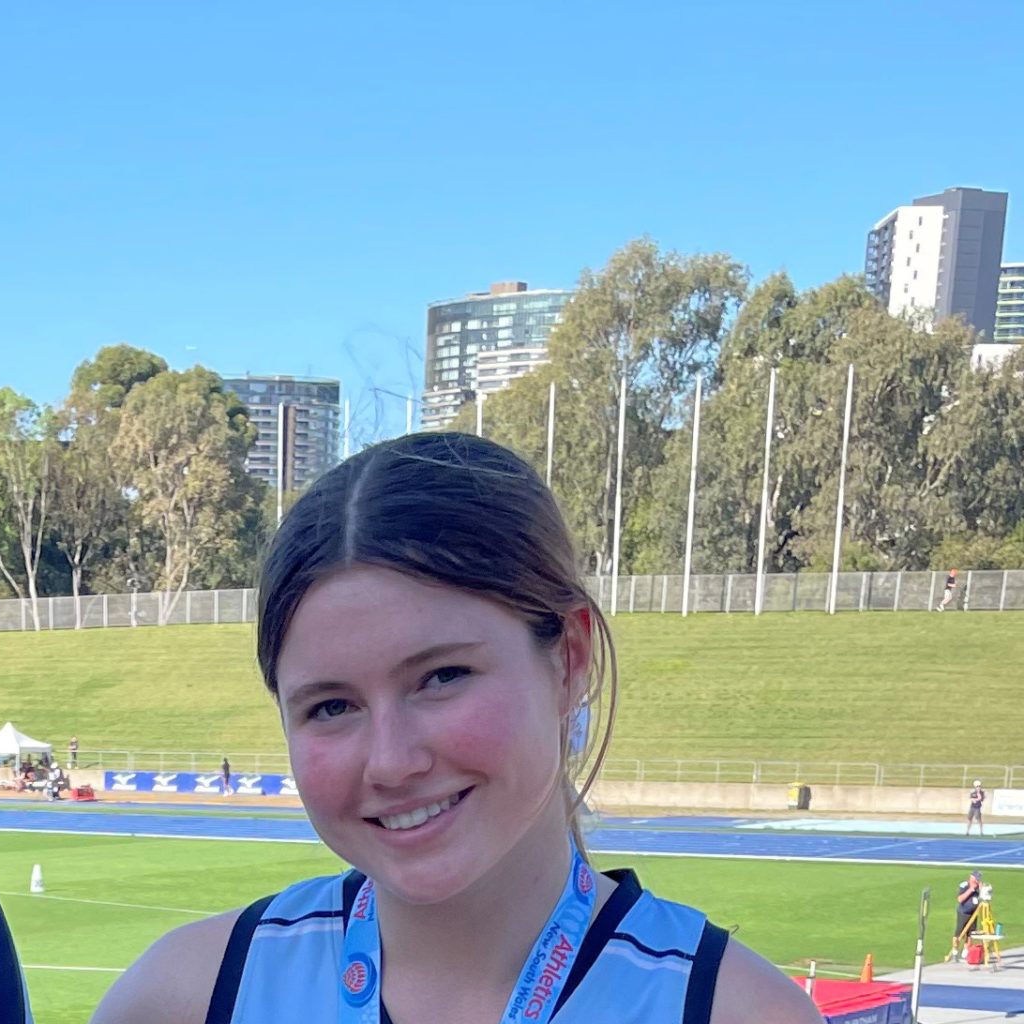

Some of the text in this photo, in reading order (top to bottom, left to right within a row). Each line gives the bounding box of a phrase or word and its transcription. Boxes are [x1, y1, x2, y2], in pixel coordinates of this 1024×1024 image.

[508, 921, 561, 1019] New South Wales
[525, 933, 573, 1020] Athletics
